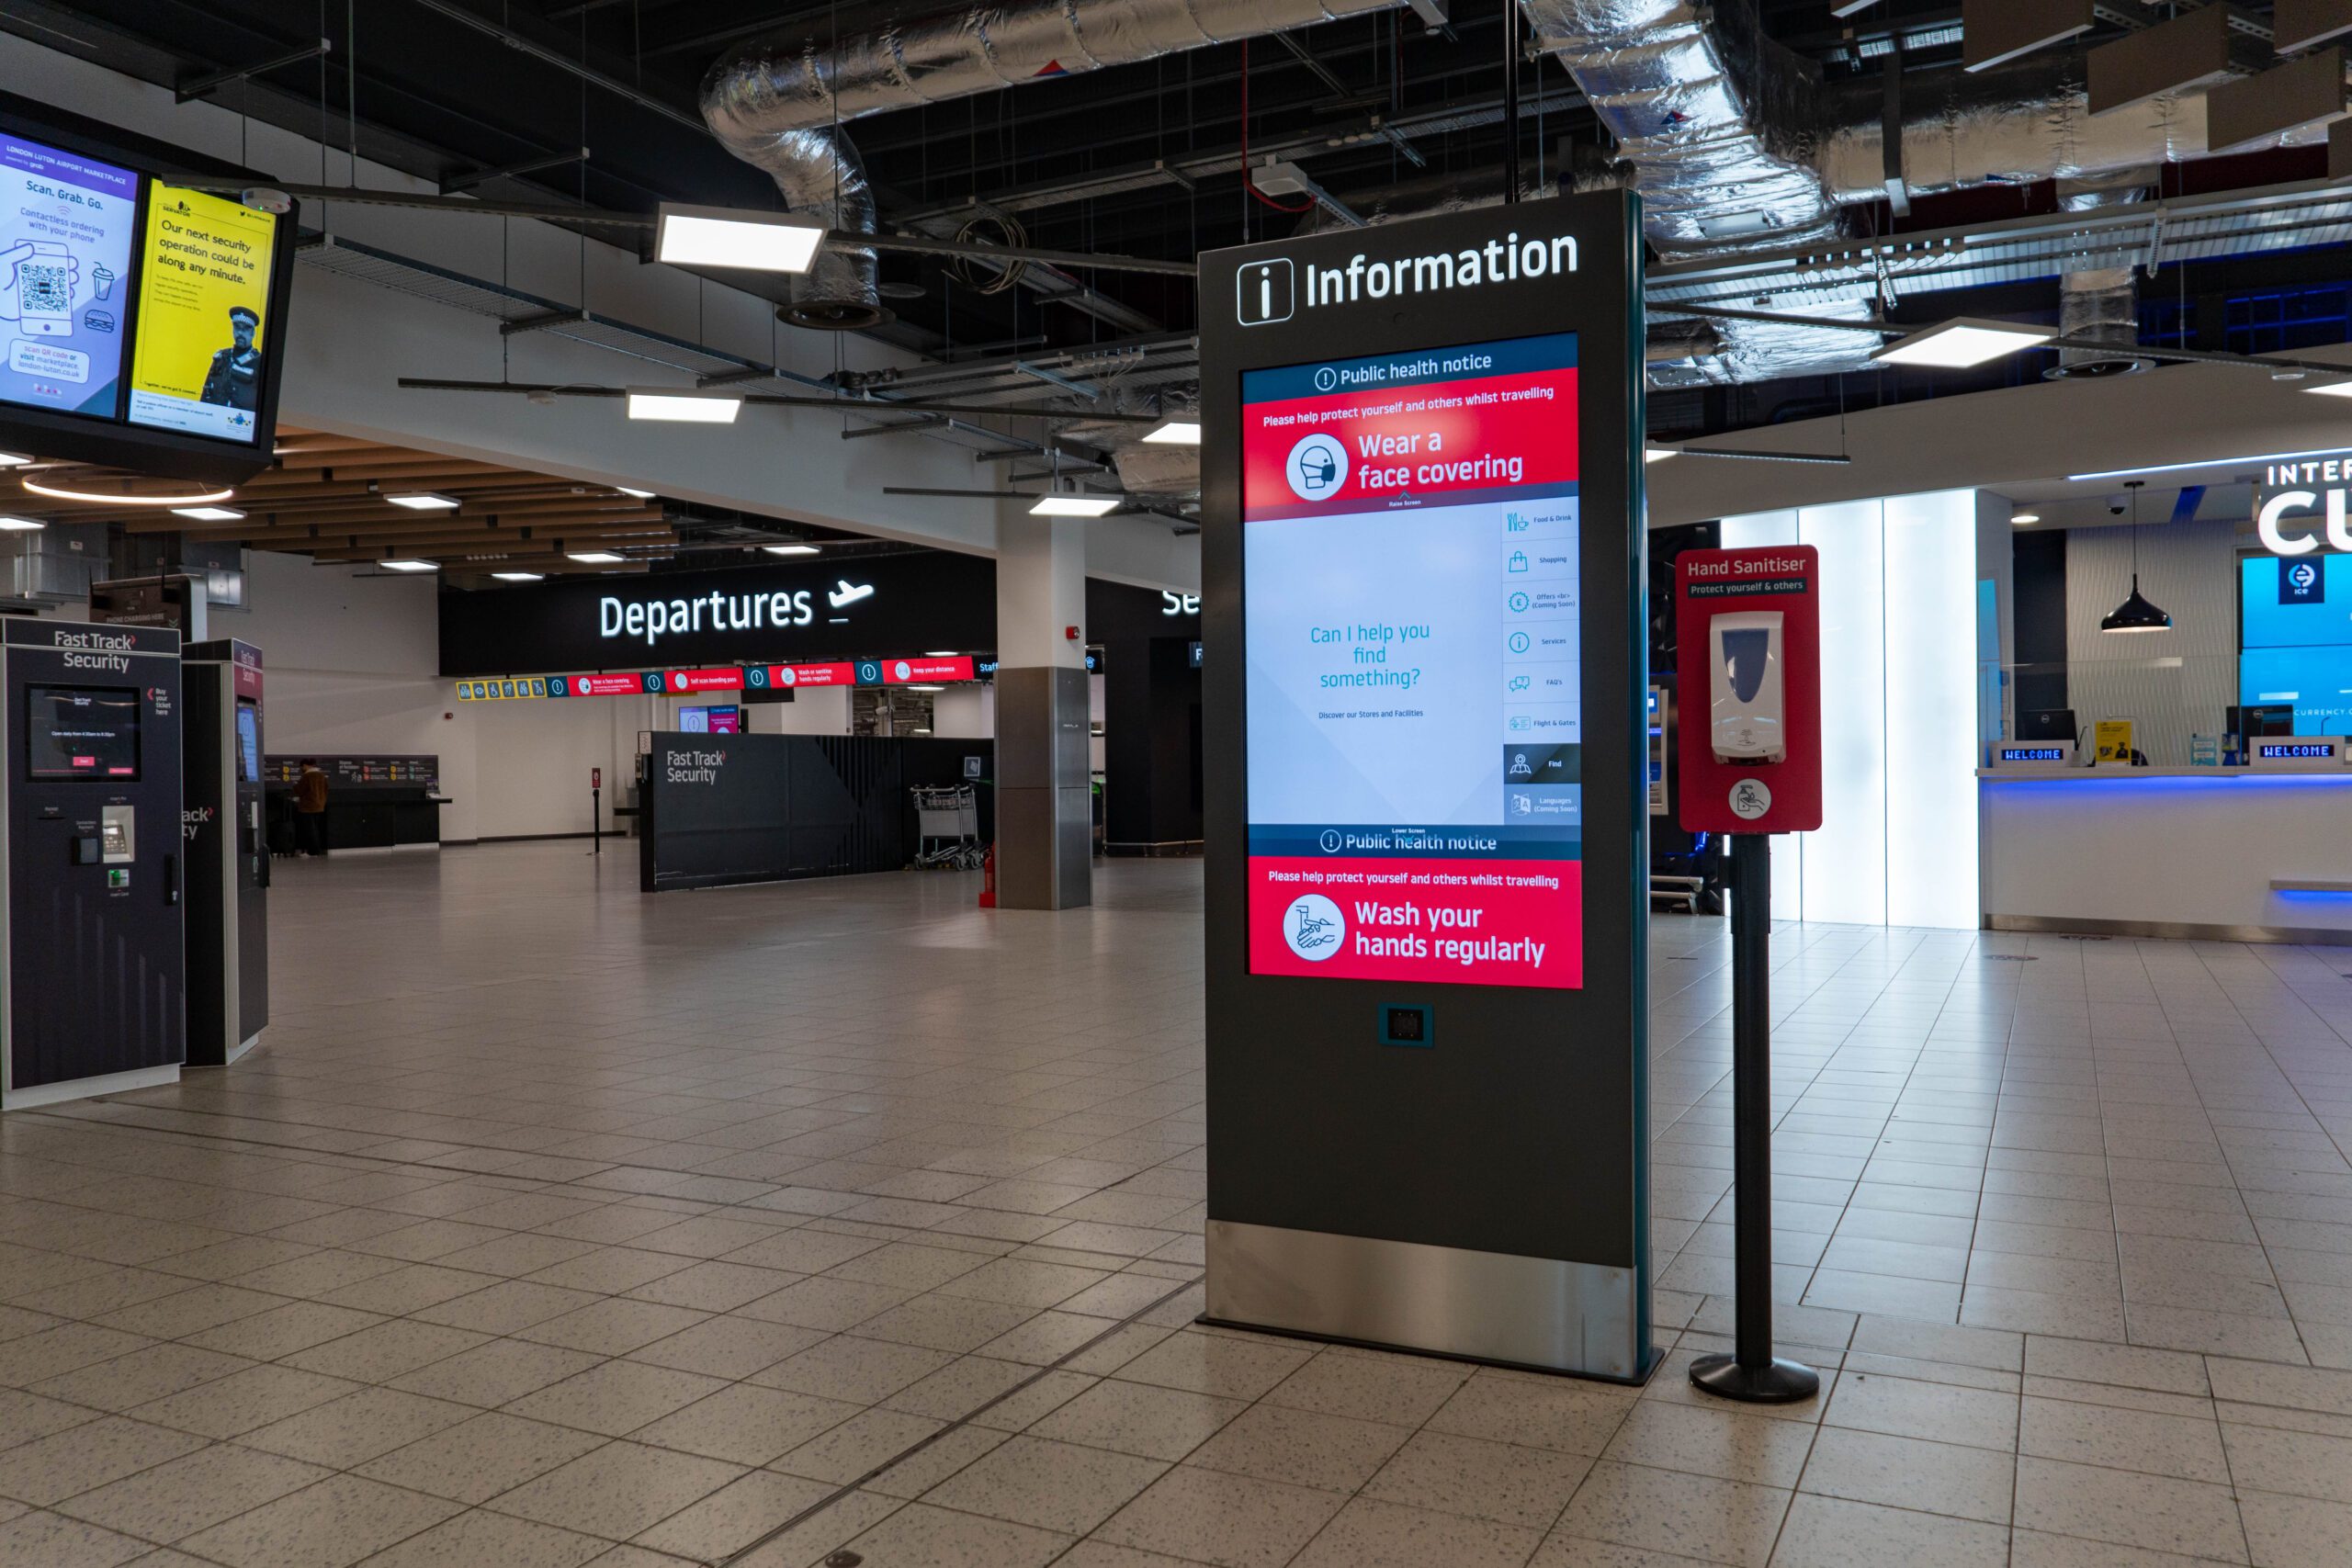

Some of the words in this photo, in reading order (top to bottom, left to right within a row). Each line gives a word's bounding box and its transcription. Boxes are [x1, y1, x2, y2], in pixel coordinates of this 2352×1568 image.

[6, 145, 33, 158] LONDON
[34, 153, 55, 164] LUTON
[56, 159, 83, 172] AIRPORT
[84, 167, 127, 185] MARKETPLACE
[27, 180, 55, 197] Scan.
[58, 189, 85, 205] Grab.
[87, 197, 104, 210] Go.
[20, 207, 69, 226] Contactless
[71, 220, 105, 237] ordering
[28, 220, 48, 231] with
[50, 227, 67, 237] your
[70, 231, 96, 243] phone
[161, 220, 183, 233] Our
[186, 229, 209, 242] next
[212, 234, 252, 254] security
[159, 239, 208, 258] operation
[211, 252, 239, 266] could
[243, 259, 254, 270] be
[157, 254, 186, 271] along
[189, 263, 207, 275] any
[209, 268, 246, 285] minute.
[1306, 232, 1577, 308] Information
[20, 353, 35, 361] visit
[24, 345, 40, 354] scan
[1340, 366, 1385, 385] Public
[1390, 359, 1438, 379] health
[1443, 354, 1492, 373] notice
[1263, 415, 1295, 427] Please
[1297, 412, 1318, 424] help
[1321, 407, 1358, 423] protect
[1362, 401, 1403, 419] yourself
[1406, 400, 1424, 412] and
[1428, 397, 1463, 410] others
[1465, 392, 1498, 405] whilst
[1501, 386, 1555, 402] travelling
[1359, 434, 1420, 457] Wear
[1428, 433, 1442, 451] a
[1359, 465, 1409, 489] face
[1418, 454, 1523, 484] covering
[1688, 560, 1729, 576] Hand
[1734, 558, 1806, 574] Sanitiser
[1690, 585, 1724, 594] Protect
[1726, 582, 1762, 593] yourself
[1764, 582, 1771, 591] &
[1773, 581, 1804, 590] others
[1558, 600, 1576, 608] Soon)
[601, 590, 812, 645] Departures
[55, 631, 88, 648] Fast
[90, 634, 131, 650] Track
[1311, 627, 1341, 643] Can
[1348, 626, 1351, 641] I
[1358, 623, 1394, 644] help
[1399, 625, 1430, 643] you
[63, 652, 130, 673] Security
[1353, 646, 1386, 664] find
[1320, 668, 1420, 690] something?
[1318, 711, 1345, 719] Discover
[1395, 709, 1424, 717] Facilities
[667, 750, 691, 766] Fast
[693, 750, 723, 766] Track
[2006, 750, 2060, 760] WELCOME
[2264, 746, 2329, 756] WELCOME
[667, 767, 716, 785] Security
[1533, 806, 1559, 814] (Coming
[1539, 797, 1572, 806] Languages
[1346, 833, 1391, 850] Public
[1396, 833, 1442, 850] health
[1448, 835, 1497, 851] notice
[1269, 871, 1300, 882] Please
[1303, 871, 1324, 885] help
[1326, 872, 1363, 885] protect
[1367, 873, 1408, 886] yourself
[1411, 874, 1430, 885] and
[1433, 874, 1467, 886] others
[1470, 874, 1503, 886] whilst
[1507, 875, 1559, 890] travelling
[1355, 901, 1419, 926] Wash
[1428, 908, 1483, 932] your
[1356, 931, 1427, 958] hands
[1435, 936, 1545, 968] regularly
